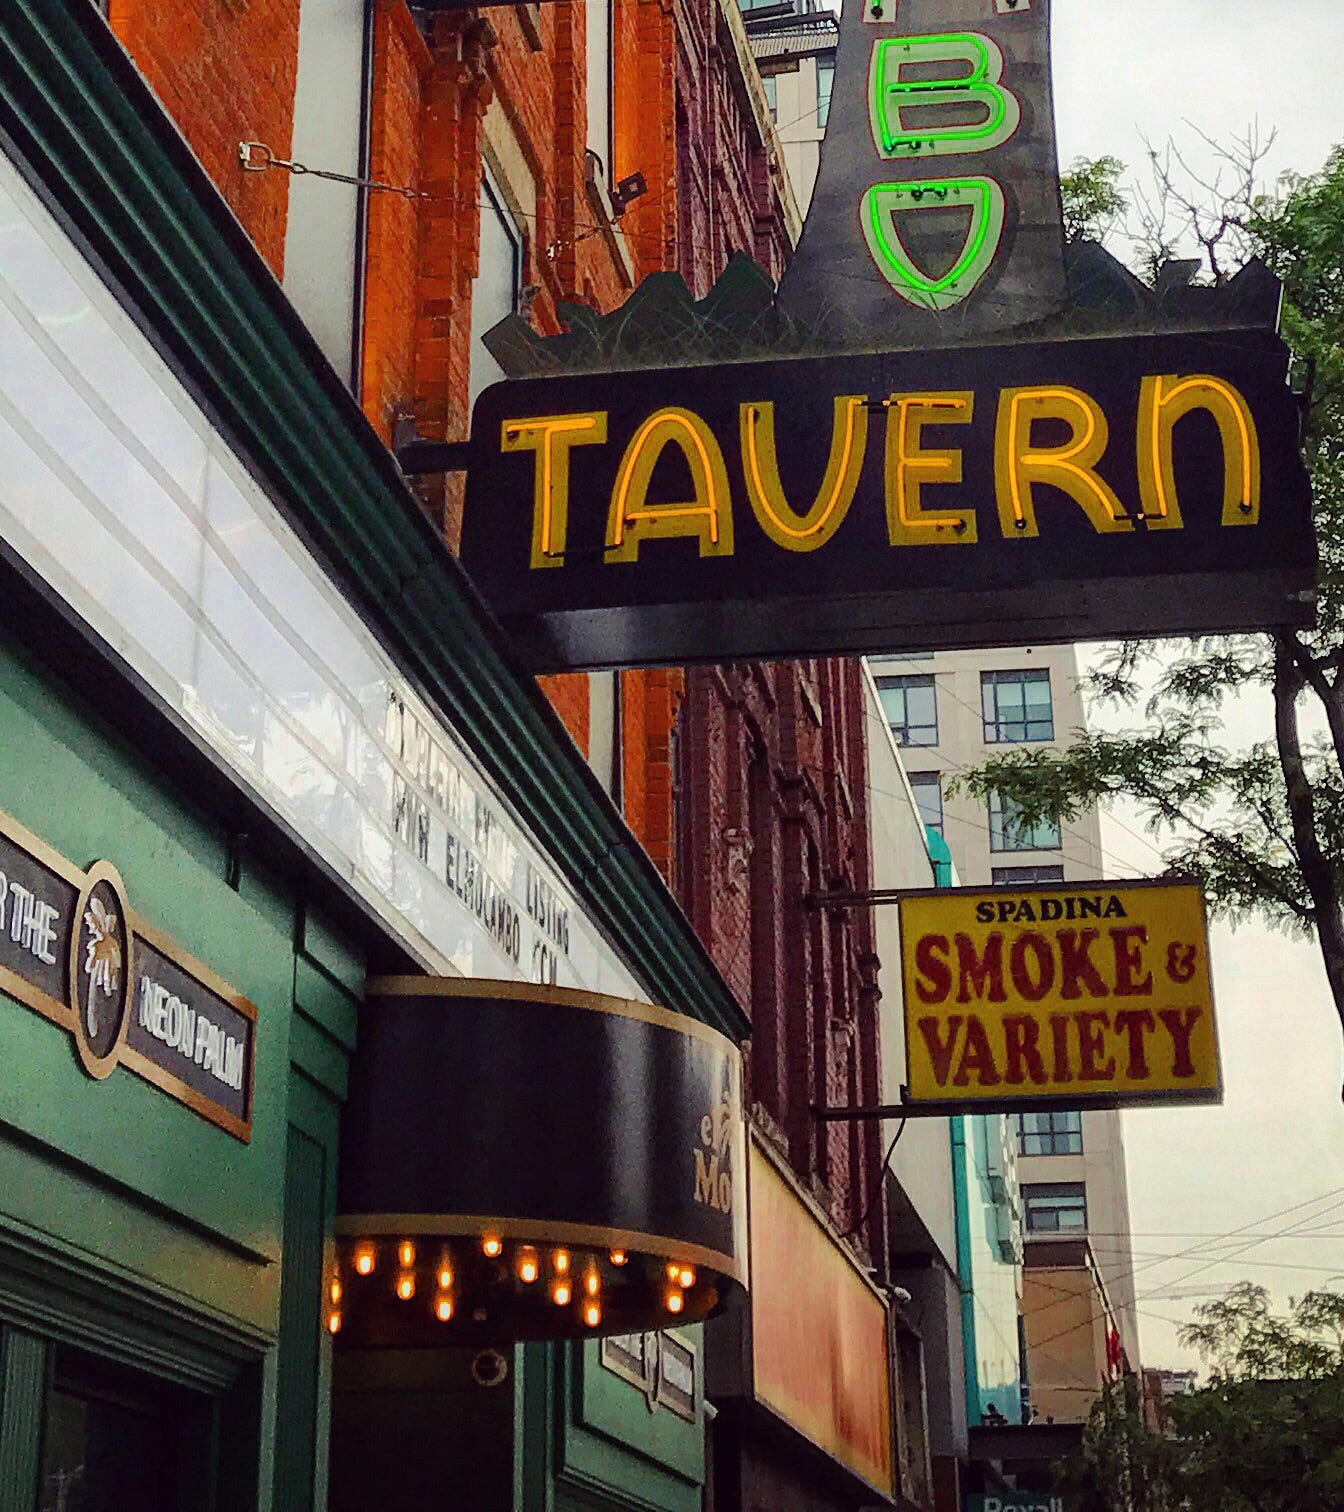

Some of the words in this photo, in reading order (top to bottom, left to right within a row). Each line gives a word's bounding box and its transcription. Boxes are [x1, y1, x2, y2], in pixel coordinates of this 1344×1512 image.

[10, 882, 60, 966] THE
[976, 895, 1128, 924] SPADINA
[915, 925, 1153, 1005] SMOKE
[1165, 940, 1197, 984] &
[140, 976, 195, 1059] NEON
[194, 1015, 244, 1092] PALM
[917, 1006, 1203, 1088] VARIETY
